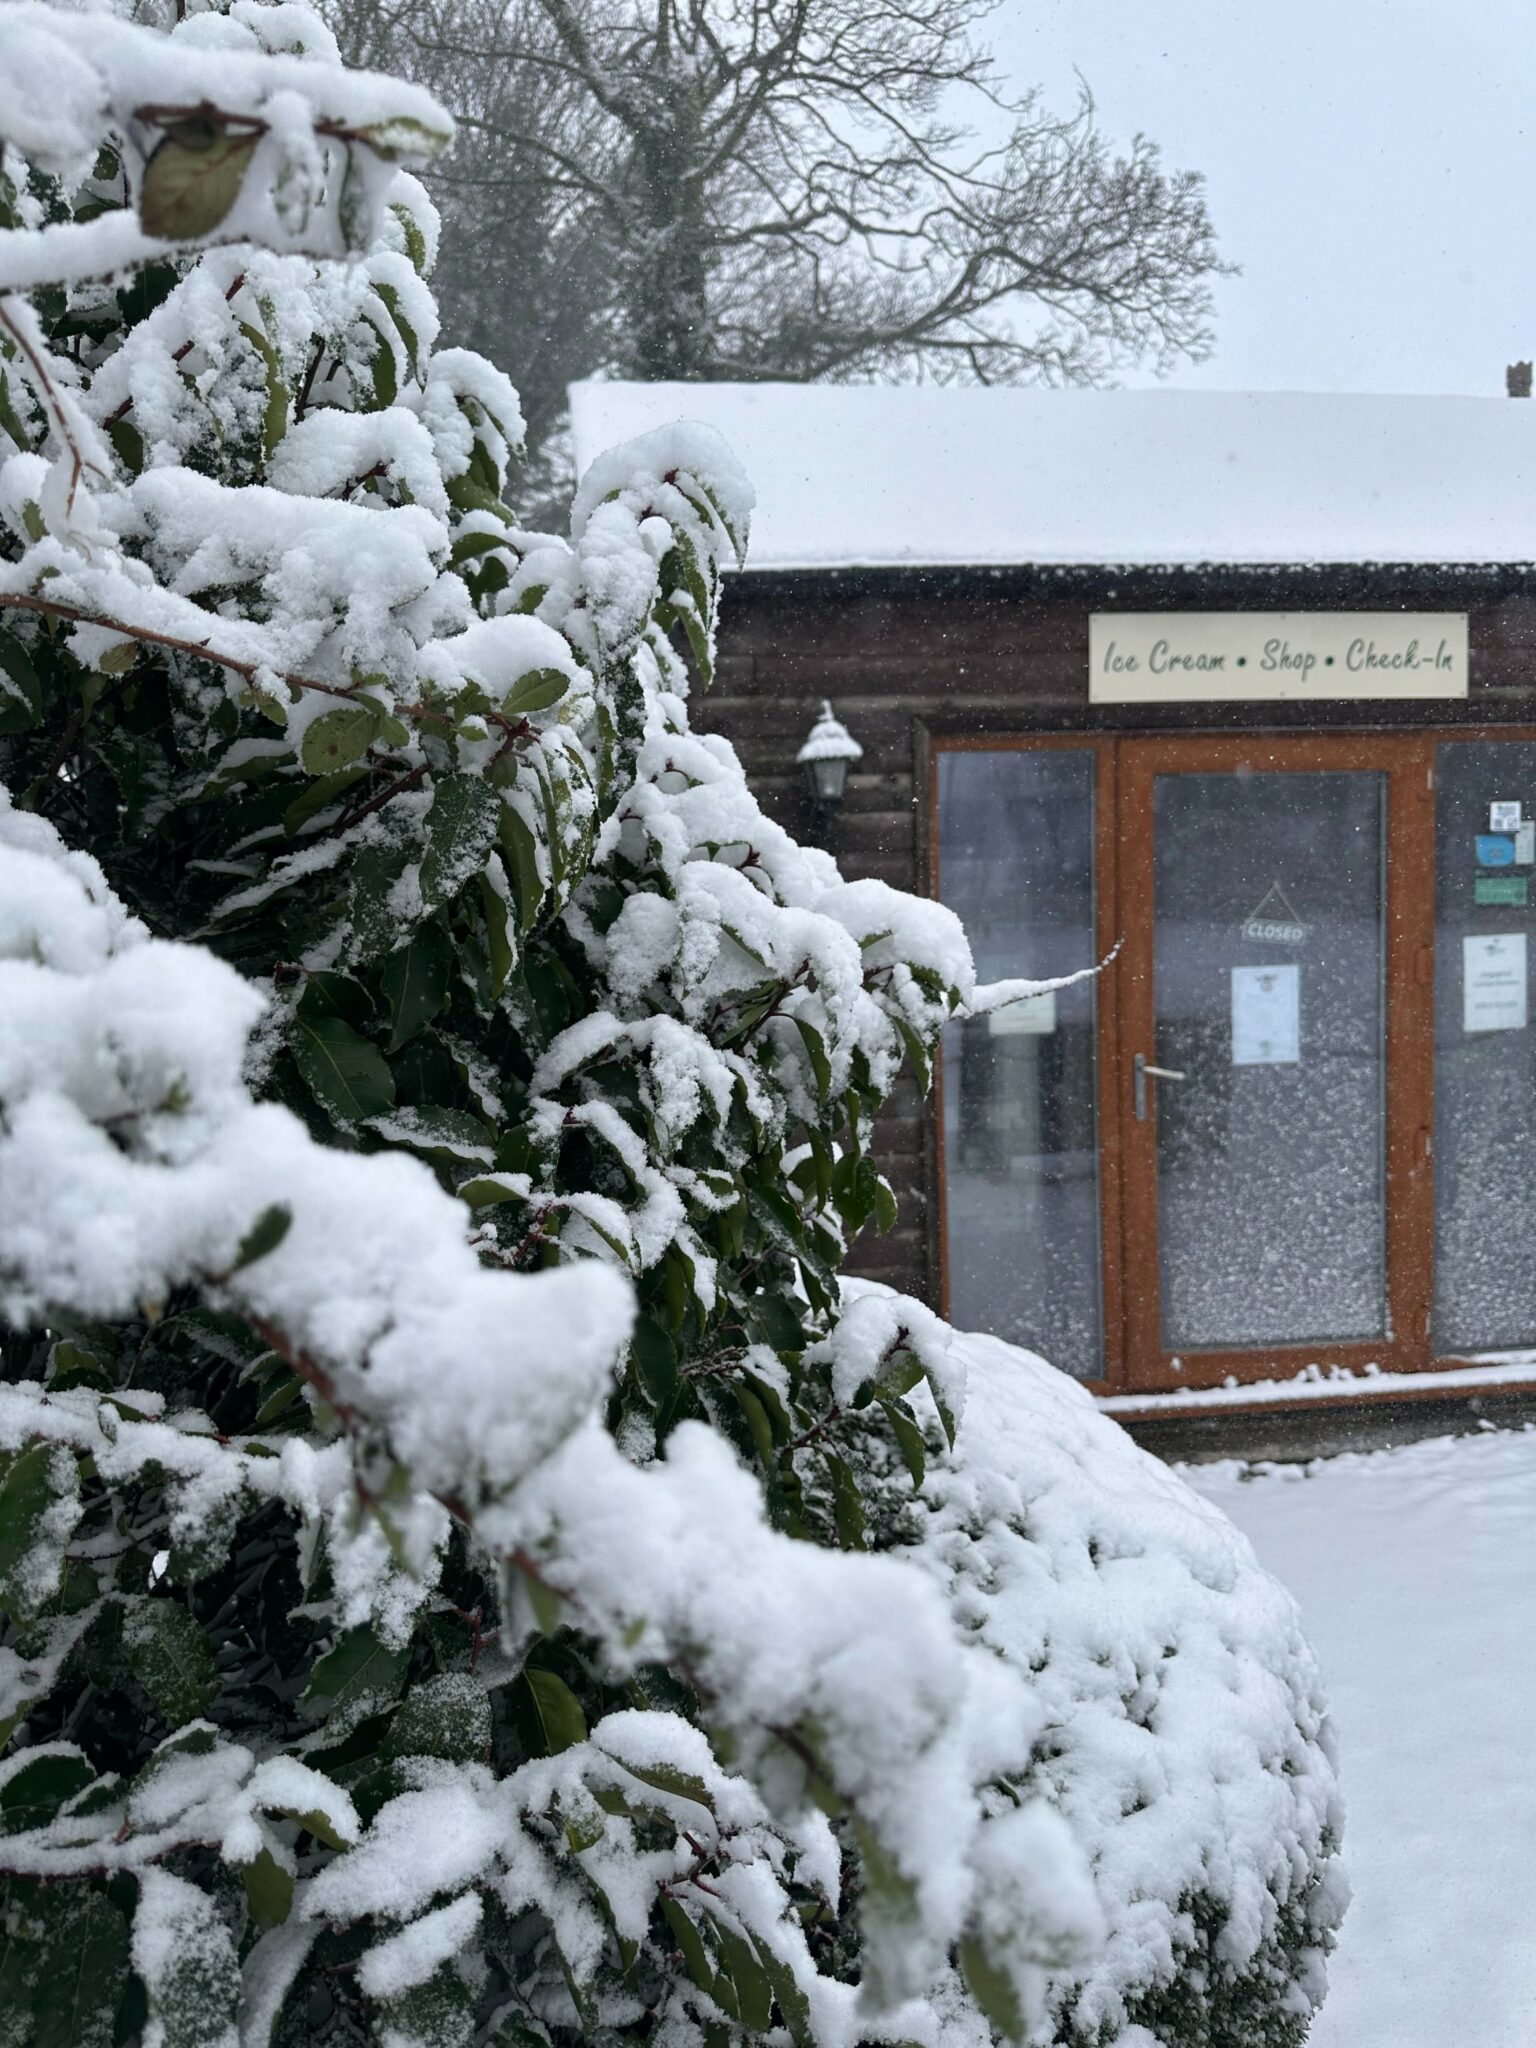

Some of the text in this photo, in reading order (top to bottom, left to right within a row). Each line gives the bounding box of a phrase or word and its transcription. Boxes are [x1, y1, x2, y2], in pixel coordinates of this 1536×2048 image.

[1103, 638, 1453, 682] Ice Cream Shop Check-In
[1247, 923, 1303, 940] CLOSED
